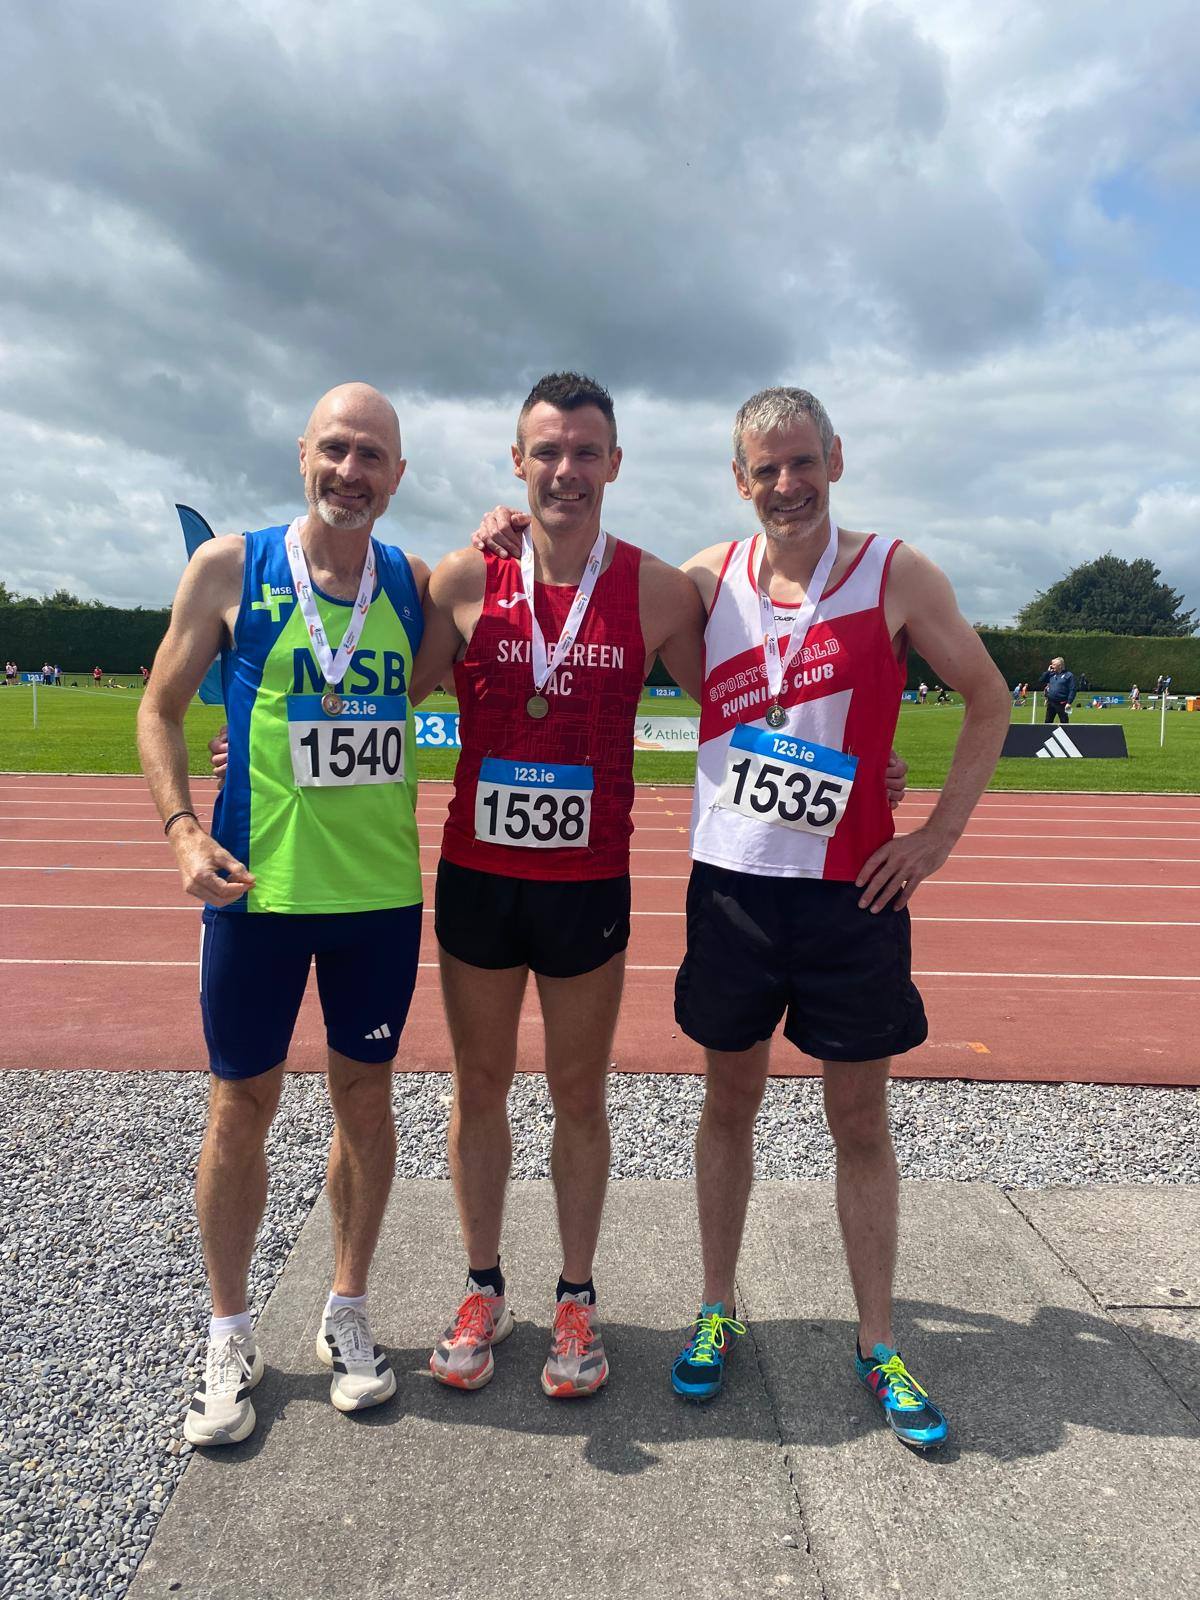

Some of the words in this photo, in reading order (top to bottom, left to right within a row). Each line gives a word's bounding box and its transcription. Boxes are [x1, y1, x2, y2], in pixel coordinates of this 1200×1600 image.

[271, 587, 292, 595] MSB
[497, 639, 624, 669] SKIBREEN
[292, 648, 406, 696] MSB
[710, 639, 840, 702] SPORTSORLD
[794, 663, 835, 689] CLUB
[545, 671, 573, 696] AC
[656, 688, 676, 696] 123.ie
[341, 700, 377, 715] 23.ie
[1098, 696, 1119, 704] 13.ie
[414, 715, 462, 746] 23.i
[655, 729, 699, 740] Athleti
[300, 727, 402, 778] 1540
[773, 738, 816, 763] 123.ie
[514, 767, 555, 783] 123.ie
[731, 758, 843, 827] 1535
[483, 789, 585, 841] 1538
